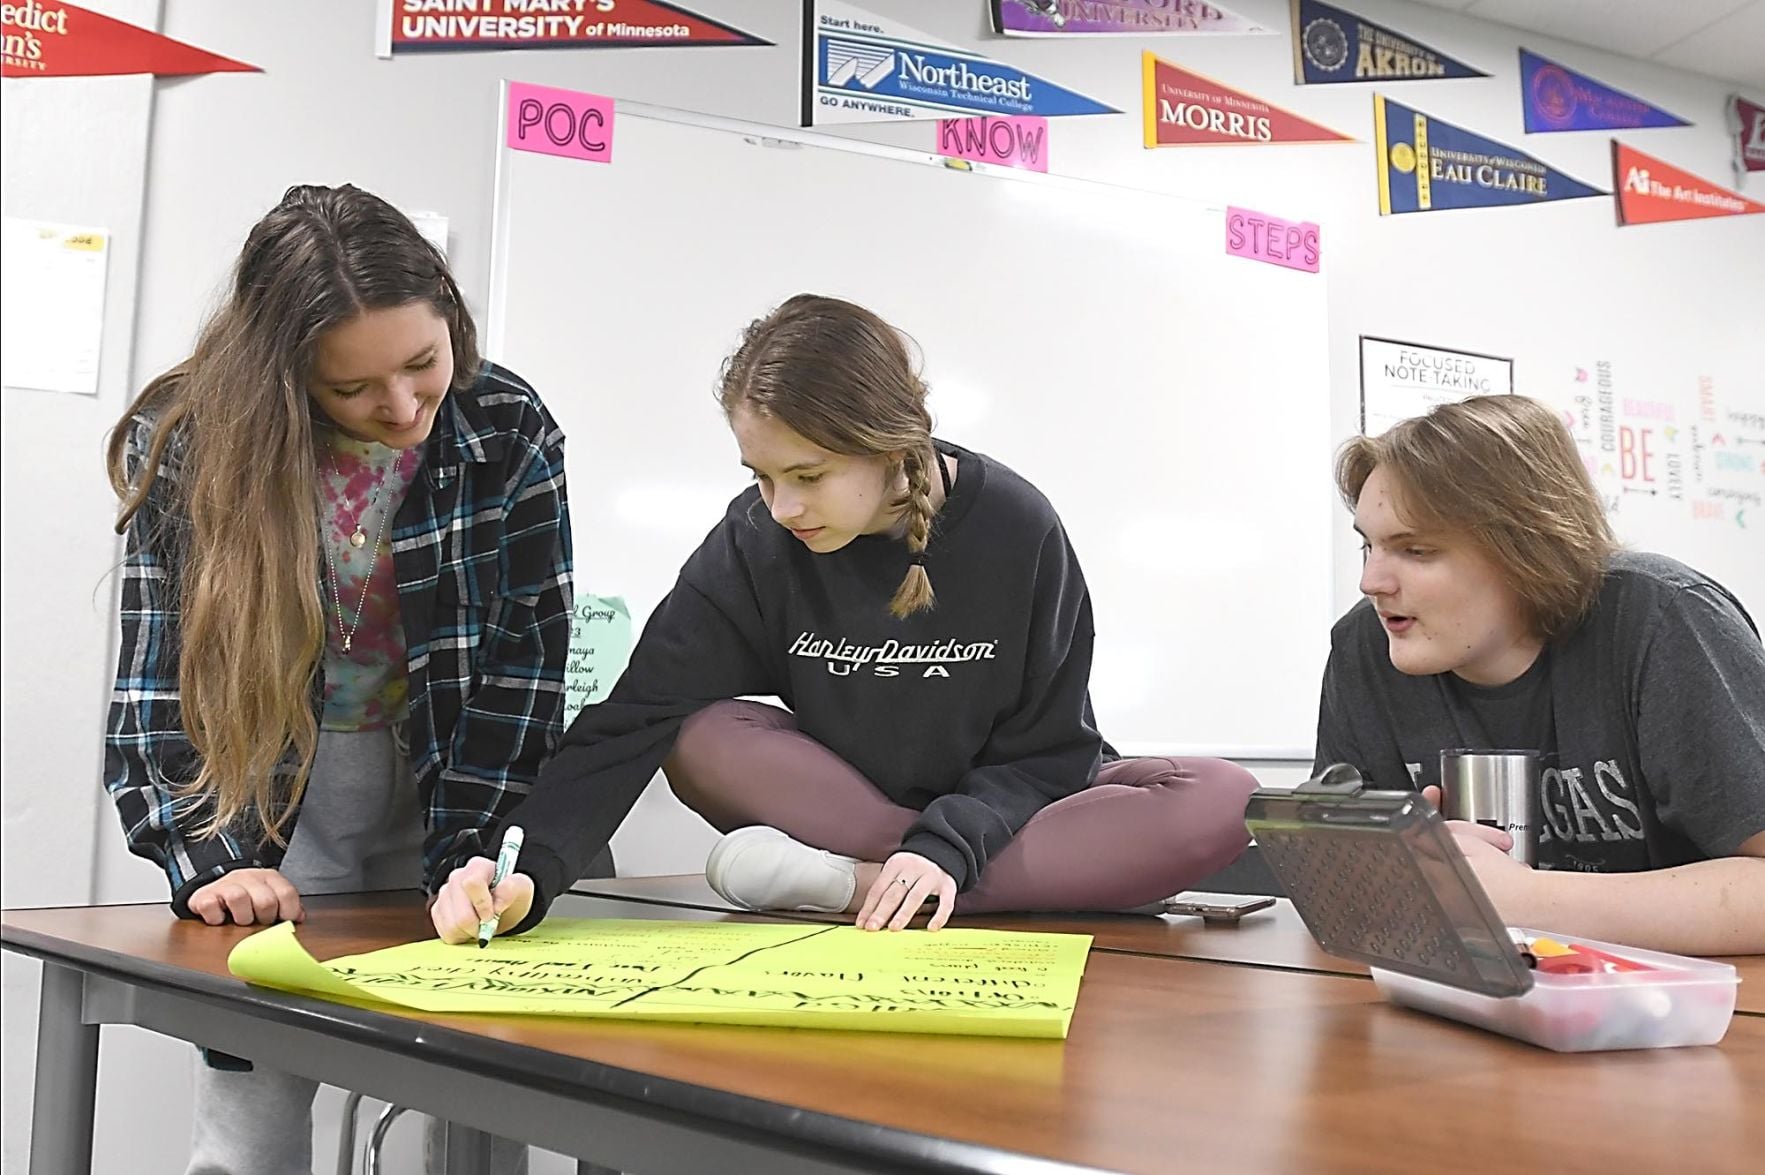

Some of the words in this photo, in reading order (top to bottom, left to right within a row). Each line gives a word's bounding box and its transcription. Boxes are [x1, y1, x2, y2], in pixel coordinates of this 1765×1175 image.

[402, 16, 584, 38] UNIVERSITY
[585, 23, 606, 37] of
[606, 23, 690, 38] Minnesota
[820, 15, 850, 29] Start
[853, 20, 885, 34] here.
[898, 51, 1033, 101] Northeast
[1356, 43, 1445, 77] AKRON
[820, 95, 839, 107] GO
[842, 99, 915, 118] ANYWHERE.
[899, 80, 949, 97] Wisconsin
[950, 88, 998, 105] Technical
[998, 97, 1034, 113] College
[1161, 83, 1210, 102] UNIVERSITY
[1224, 95, 1270, 113] MINNESOTA
[518, 99, 606, 152] POC
[1160, 98, 1272, 142] MORRIS
[942, 116, 1043, 164] KNOW
[1431, 147, 1488, 164] UNIVERSITY
[1495, 156, 1546, 173] WISCONSIN
[1431, 158, 1472, 184] EAU
[1476, 165, 1547, 195] CLAIRE
[1650, 181, 1672, 199] The
[1673, 186, 1693, 202] Art
[1229, 214, 1319, 265] STEPS
[1400, 350, 1475, 375] FOCUSED
[1597, 360, 1616, 452] COURAGEOUS
[1619, 425, 1656, 482] BE
[1667, 453, 1683, 501] LOVELY
[582, 605, 616, 623] Group
[1539, 758, 1645, 843] GAS
